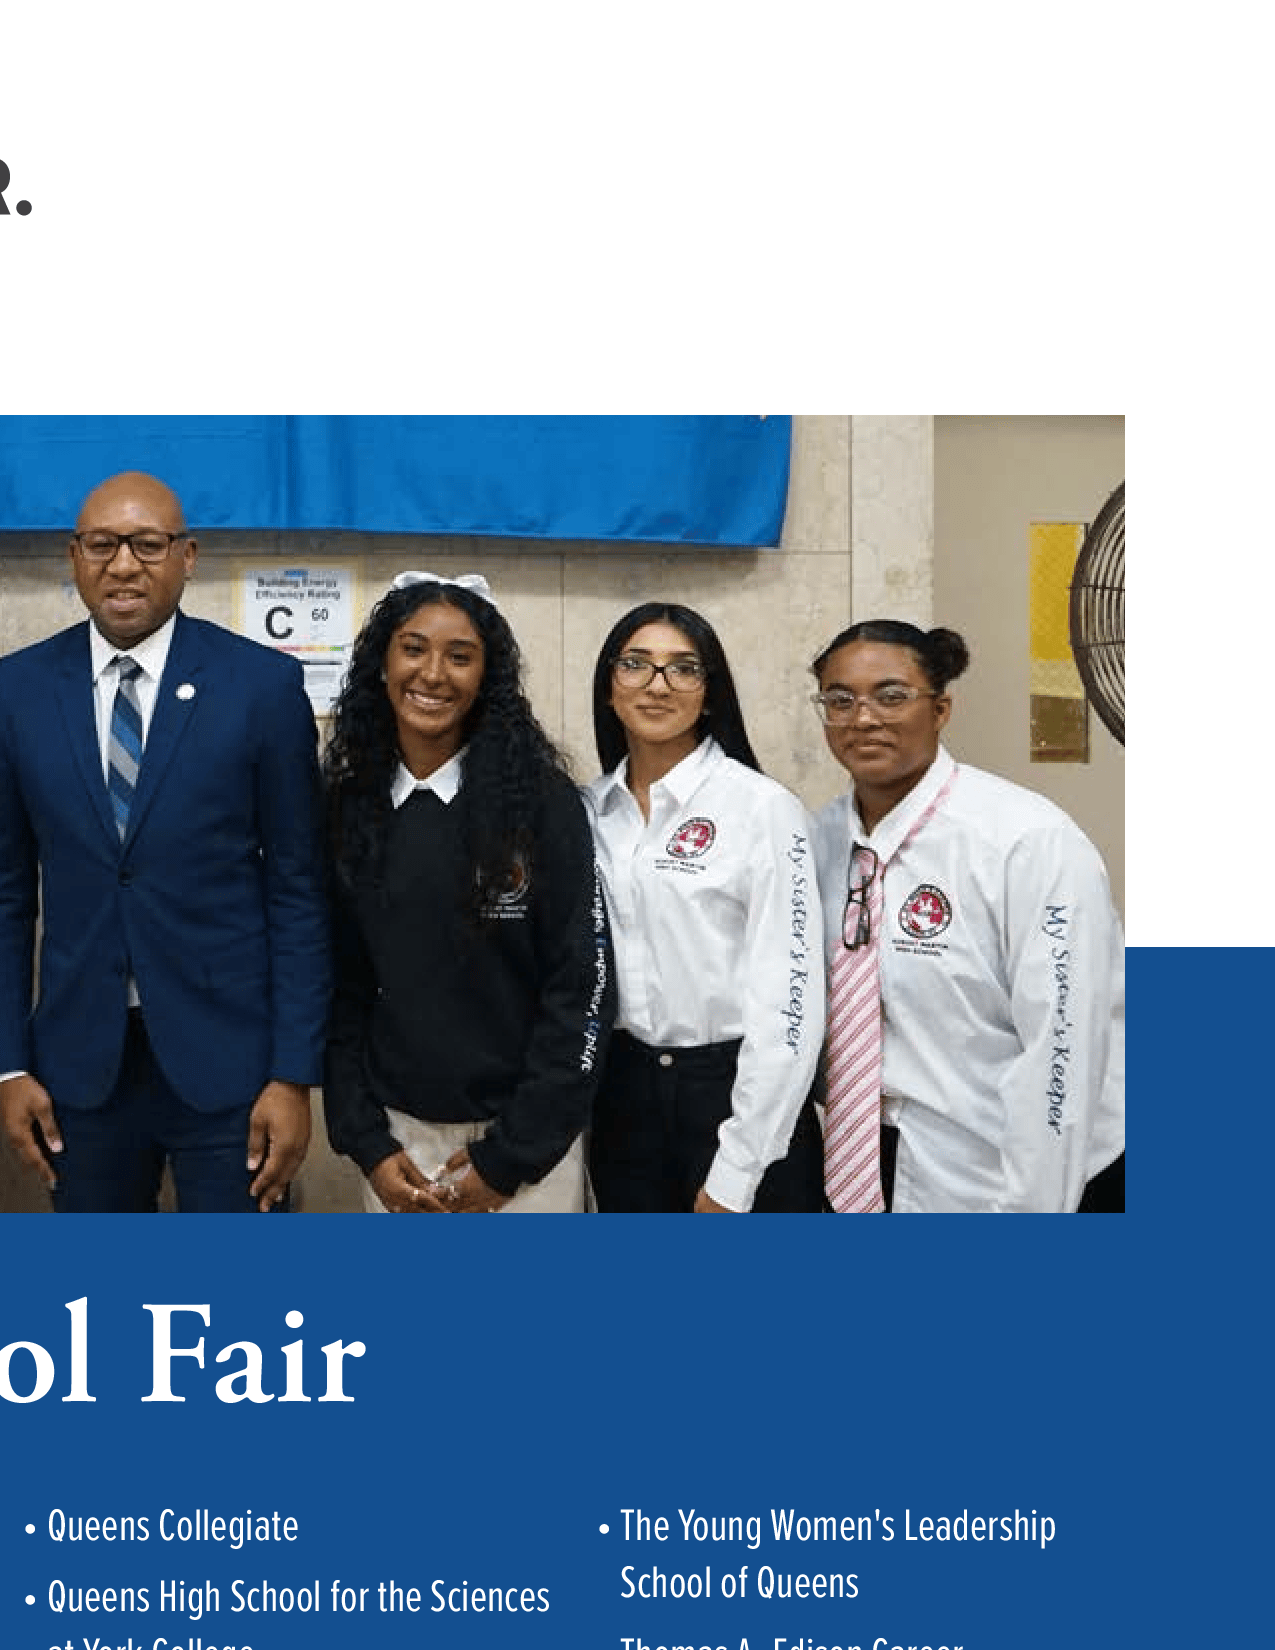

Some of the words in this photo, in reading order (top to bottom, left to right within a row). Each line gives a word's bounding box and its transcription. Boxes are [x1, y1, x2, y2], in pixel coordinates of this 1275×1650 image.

[256, 590, 304, 601] Efficiency
[308, 589, 340, 601] Rating
[258, 577, 298, 589] Building
[302, 578, 336, 589] Energy
[265, 605, 294, 639] C
[311, 607, 329, 621] 60
[787, 833, 807, 868] My
[789, 873, 811, 963] Sister's
[1041, 904, 1068, 940] My
[780, 968, 808, 1055] Keeper
[1045, 1047, 1071, 1135] Keeper
[141, 1304, 366, 1403] Fair
[621, 1509, 669, 1541] The
[678, 1509, 760, 1549] Young
[771, 1509, 894, 1541] Women's
[906, 1509, 1055, 1549] Leadership
[49, 1580, 149, 1613] Queens
[161, 1580, 219, 1620] High
[231, 1580, 319, 1612] School
[331, 1580, 369, 1612] for
[378, 1580, 421, 1612] the
[431, 1580, 549, 1612] Sciences
[621, 1566, 710, 1598] School
[722, 1566, 748, 1598] of
[758, 1566, 858, 1599] Queens
